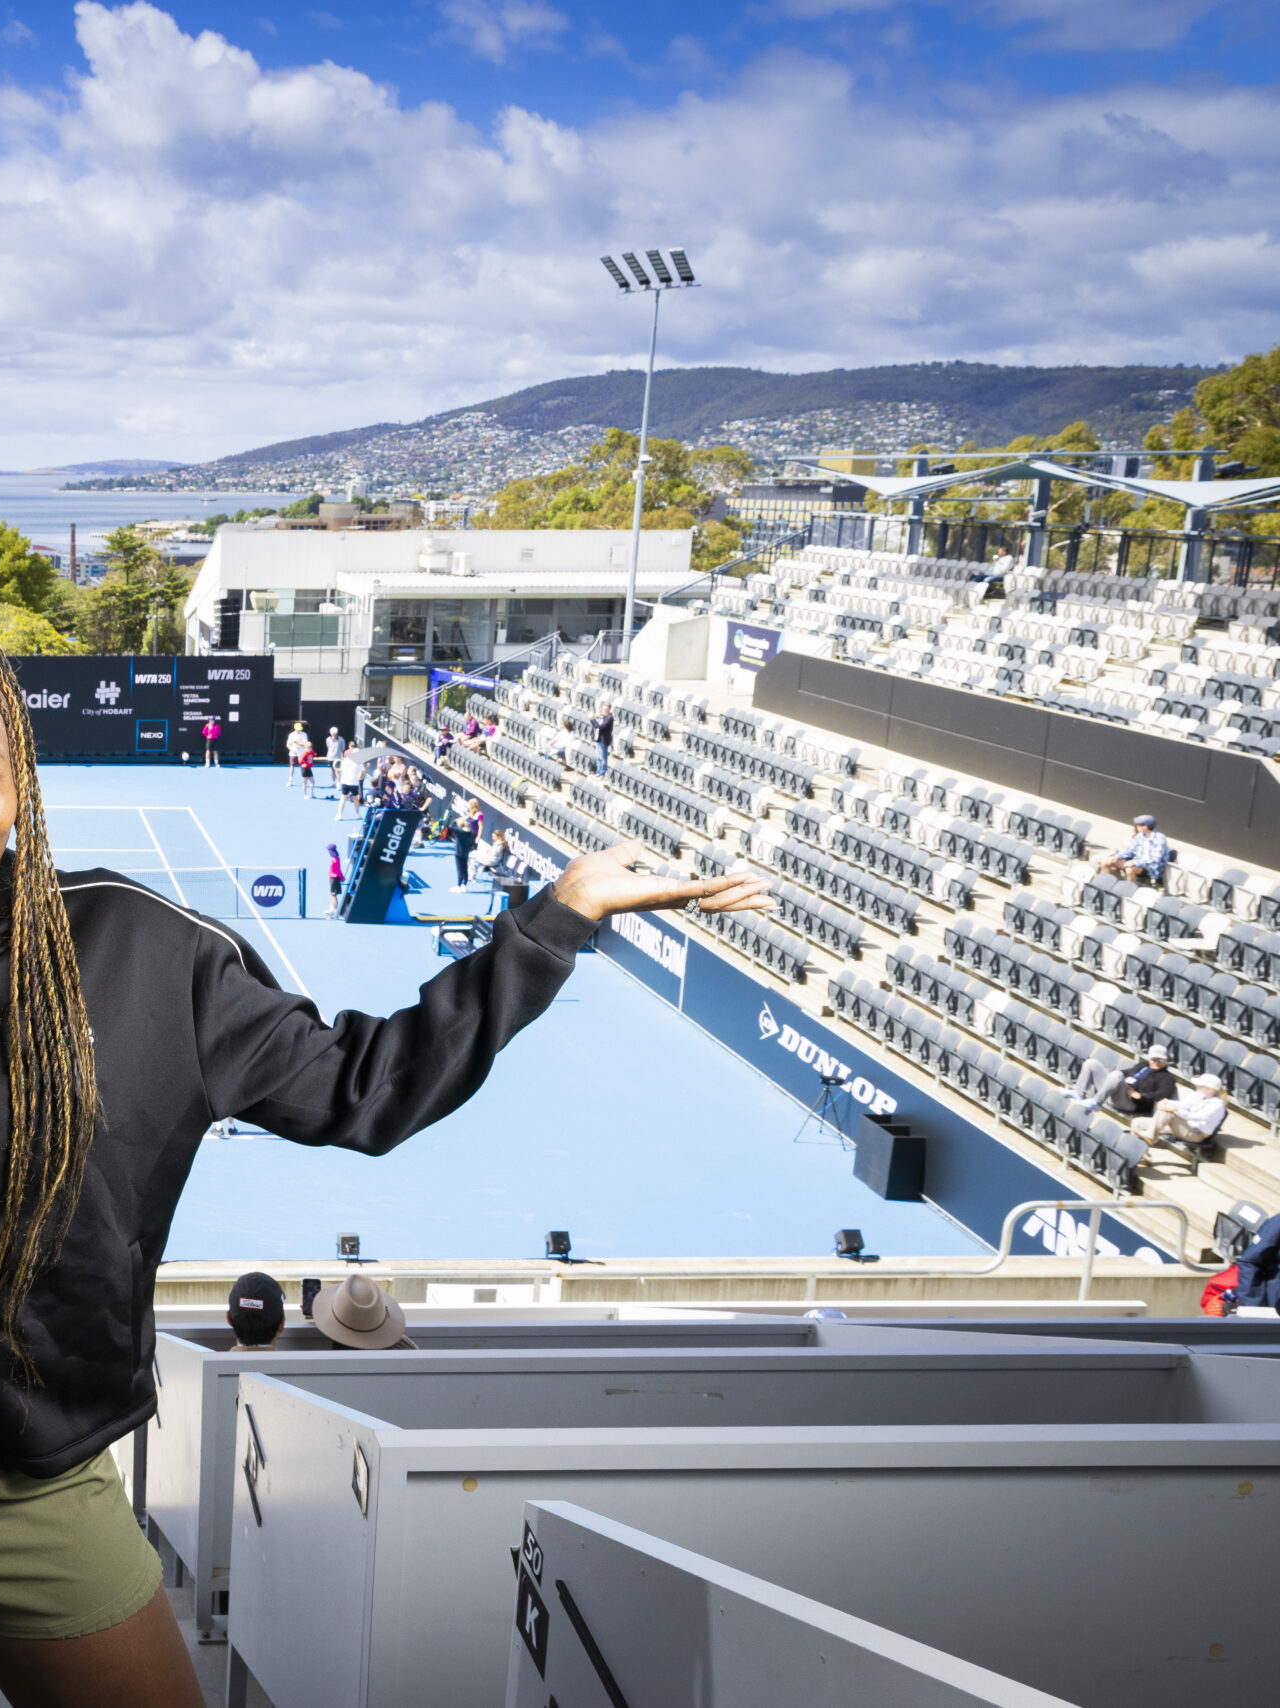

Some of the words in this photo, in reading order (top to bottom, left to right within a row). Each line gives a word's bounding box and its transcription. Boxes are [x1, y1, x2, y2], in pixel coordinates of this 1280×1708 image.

[135, 674, 158, 684] WTA
[158, 674, 172, 684] 250
[208, 669, 234, 680] WTA
[235, 669, 251, 680] 250
[95, 708, 103, 716] of
[379, 818, 407, 863] Haier
[253, 885, 283, 897] WTA
[777, 1024, 898, 1115] DUNLOP
[524, 1531, 542, 1576] 50
[525, 1593, 539, 1650] K
